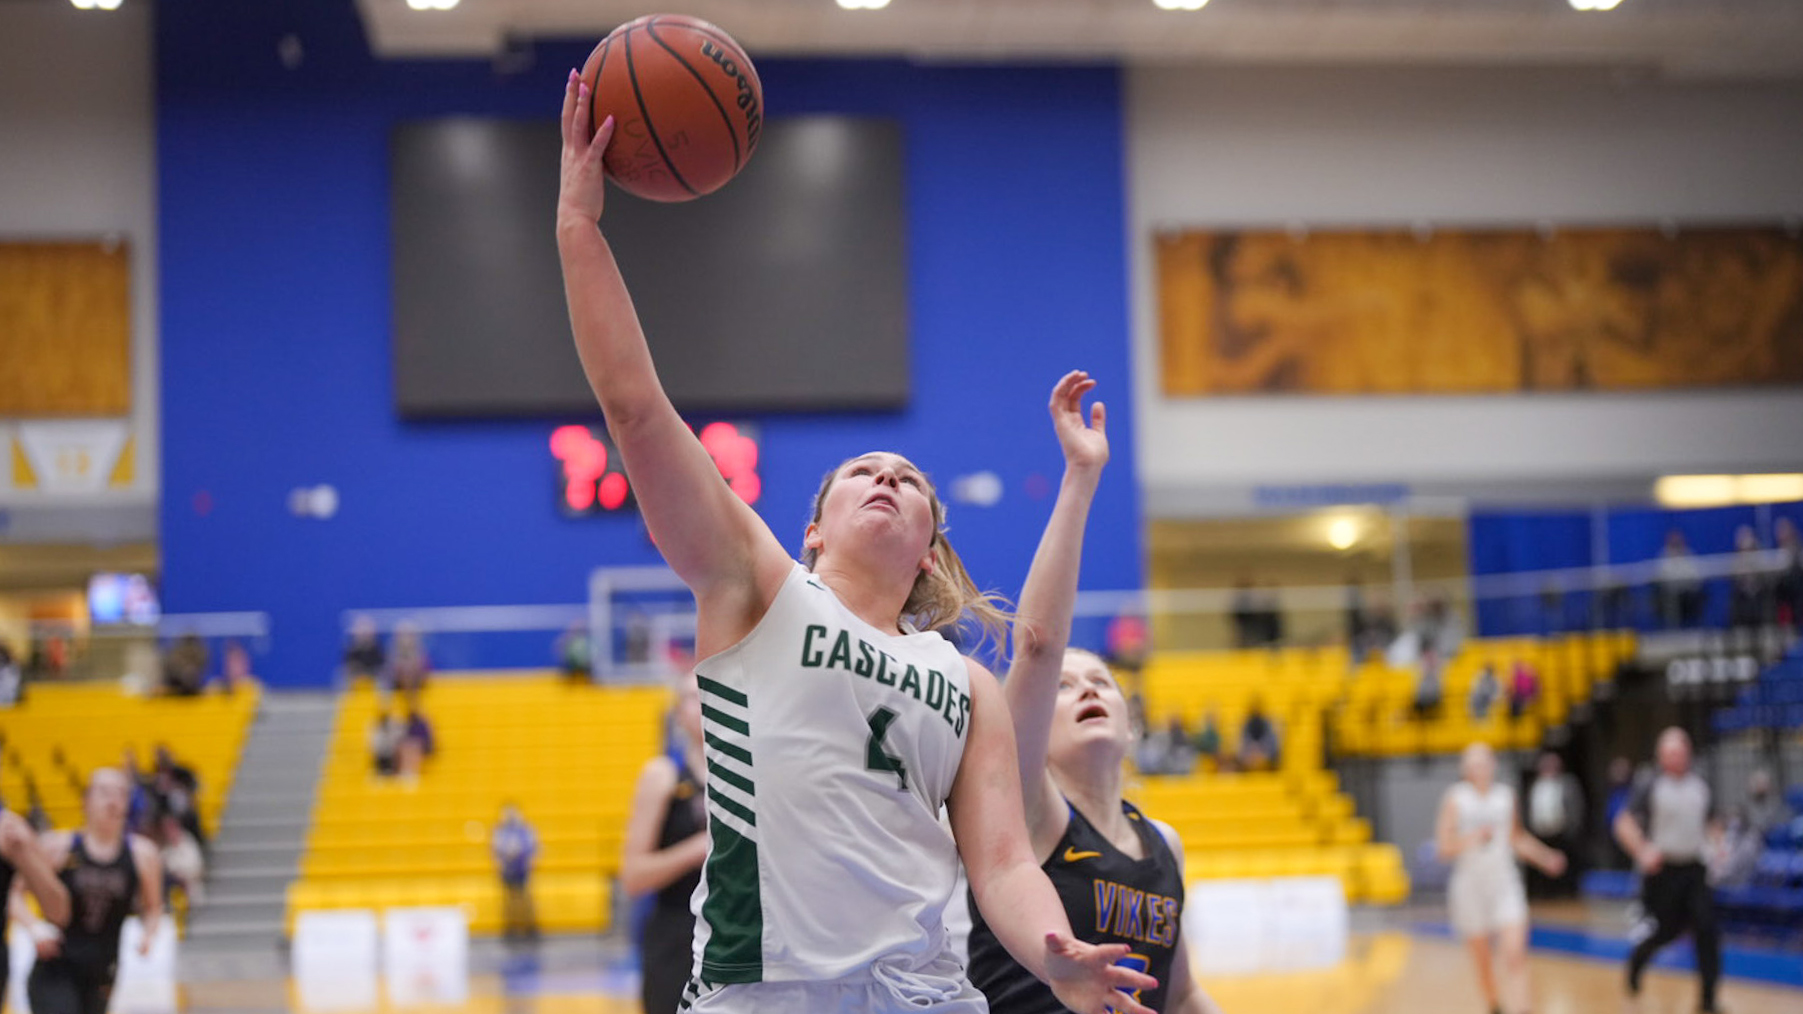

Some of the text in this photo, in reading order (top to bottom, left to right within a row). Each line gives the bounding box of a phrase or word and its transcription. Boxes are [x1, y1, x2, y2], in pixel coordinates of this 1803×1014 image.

[801, 624, 971, 739] CASCADES
[864, 703, 910, 793] 4
[1094, 879, 1179, 949] VIKES
